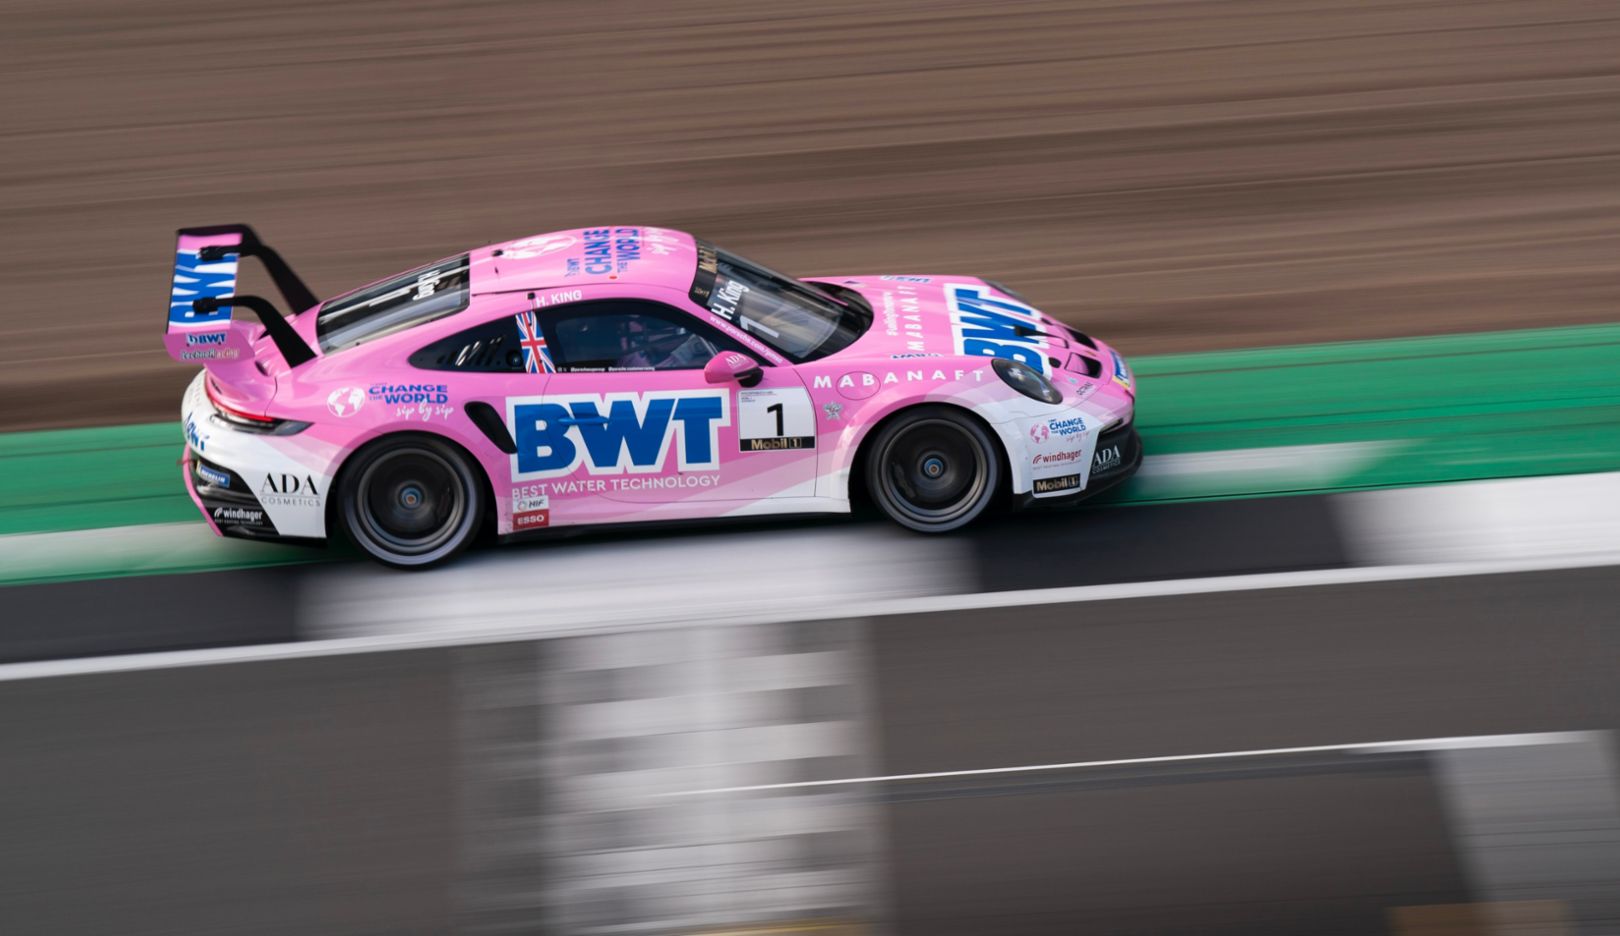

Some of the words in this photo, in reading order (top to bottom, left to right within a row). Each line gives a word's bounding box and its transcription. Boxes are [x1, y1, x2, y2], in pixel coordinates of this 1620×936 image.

[583, 229, 613, 275] CHANGE
[615, 228, 640, 261] WORLD
[536, 295, 549, 308] H.
[551, 290, 582, 305] KING
[717, 280, 750, 304] King
[710, 302, 735, 320] H.
[740, 315, 780, 338] 1
[954, 288, 1044, 375] BWT
[813, 370, 984, 389] MABANAFT
[368, 384, 448, 395] CHANGE
[384, 393, 448, 404] WORLD
[396, 405, 415, 420] sip
[418, 398, 432, 421] by
[435, 404, 454, 420] sip
[767, 403, 784, 437] 1
[1049, 418, 1083, 431] CHANGE
[514, 396, 722, 474] BWT
[1059, 425, 1087, 436] WORLD
[751, 438, 787, 450] Mobil
[1043, 449, 1082, 463] windhager
[1093, 445, 1121, 465] ADA
[261, 472, 320, 495] ADA
[512, 483, 547, 500] BEST
[552, 479, 606, 494] WATER
[611, 474, 720, 491] TECHNOLOGY
[1036, 478, 1067, 491] Mobil
[261, 497, 321, 507] COSMETICS
[224, 507, 263, 521] windhager
